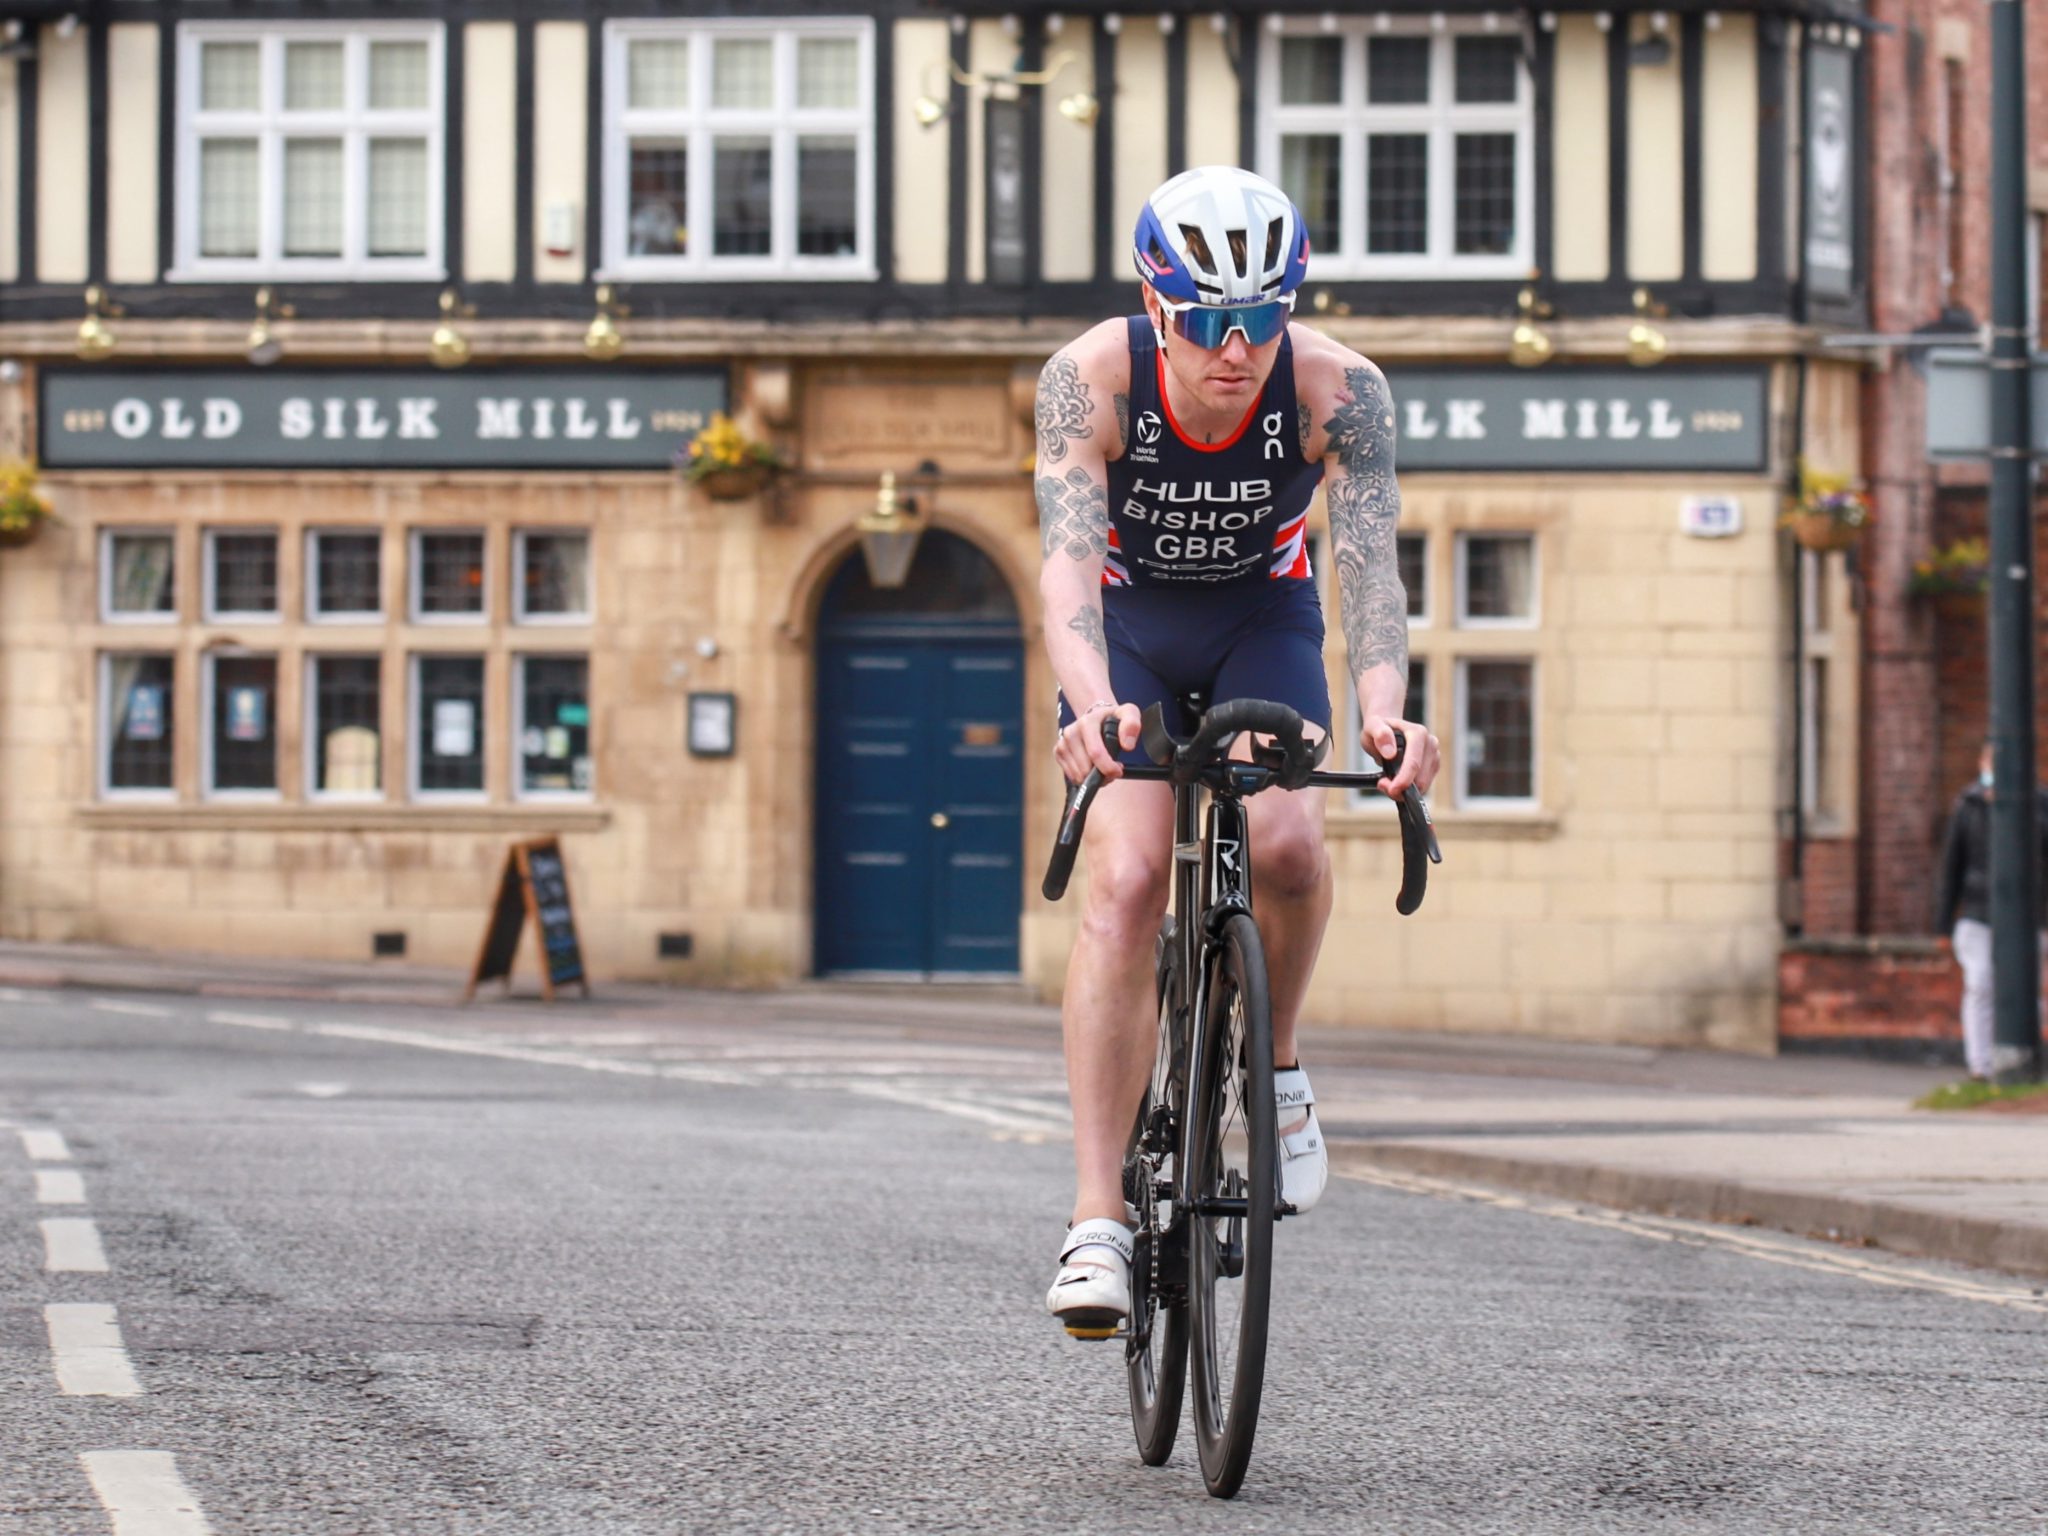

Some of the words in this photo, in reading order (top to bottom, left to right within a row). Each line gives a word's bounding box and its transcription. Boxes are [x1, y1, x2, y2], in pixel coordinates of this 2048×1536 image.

[111, 398, 242, 439] OLD
[281, 398, 438, 439] SILK
[477, 398, 641, 439] MILL
[1404, 399, 1487, 439] LK
[1522, 399, 1683, 439] MILL
[1130, 453, 1159, 463] Triathlon
[1136, 446, 1156, 455] World
[1132, 478, 1272, 502] HUUB
[1122, 498, 1274, 531] BISHOP
[1154, 535, 1237, 559] GBR
